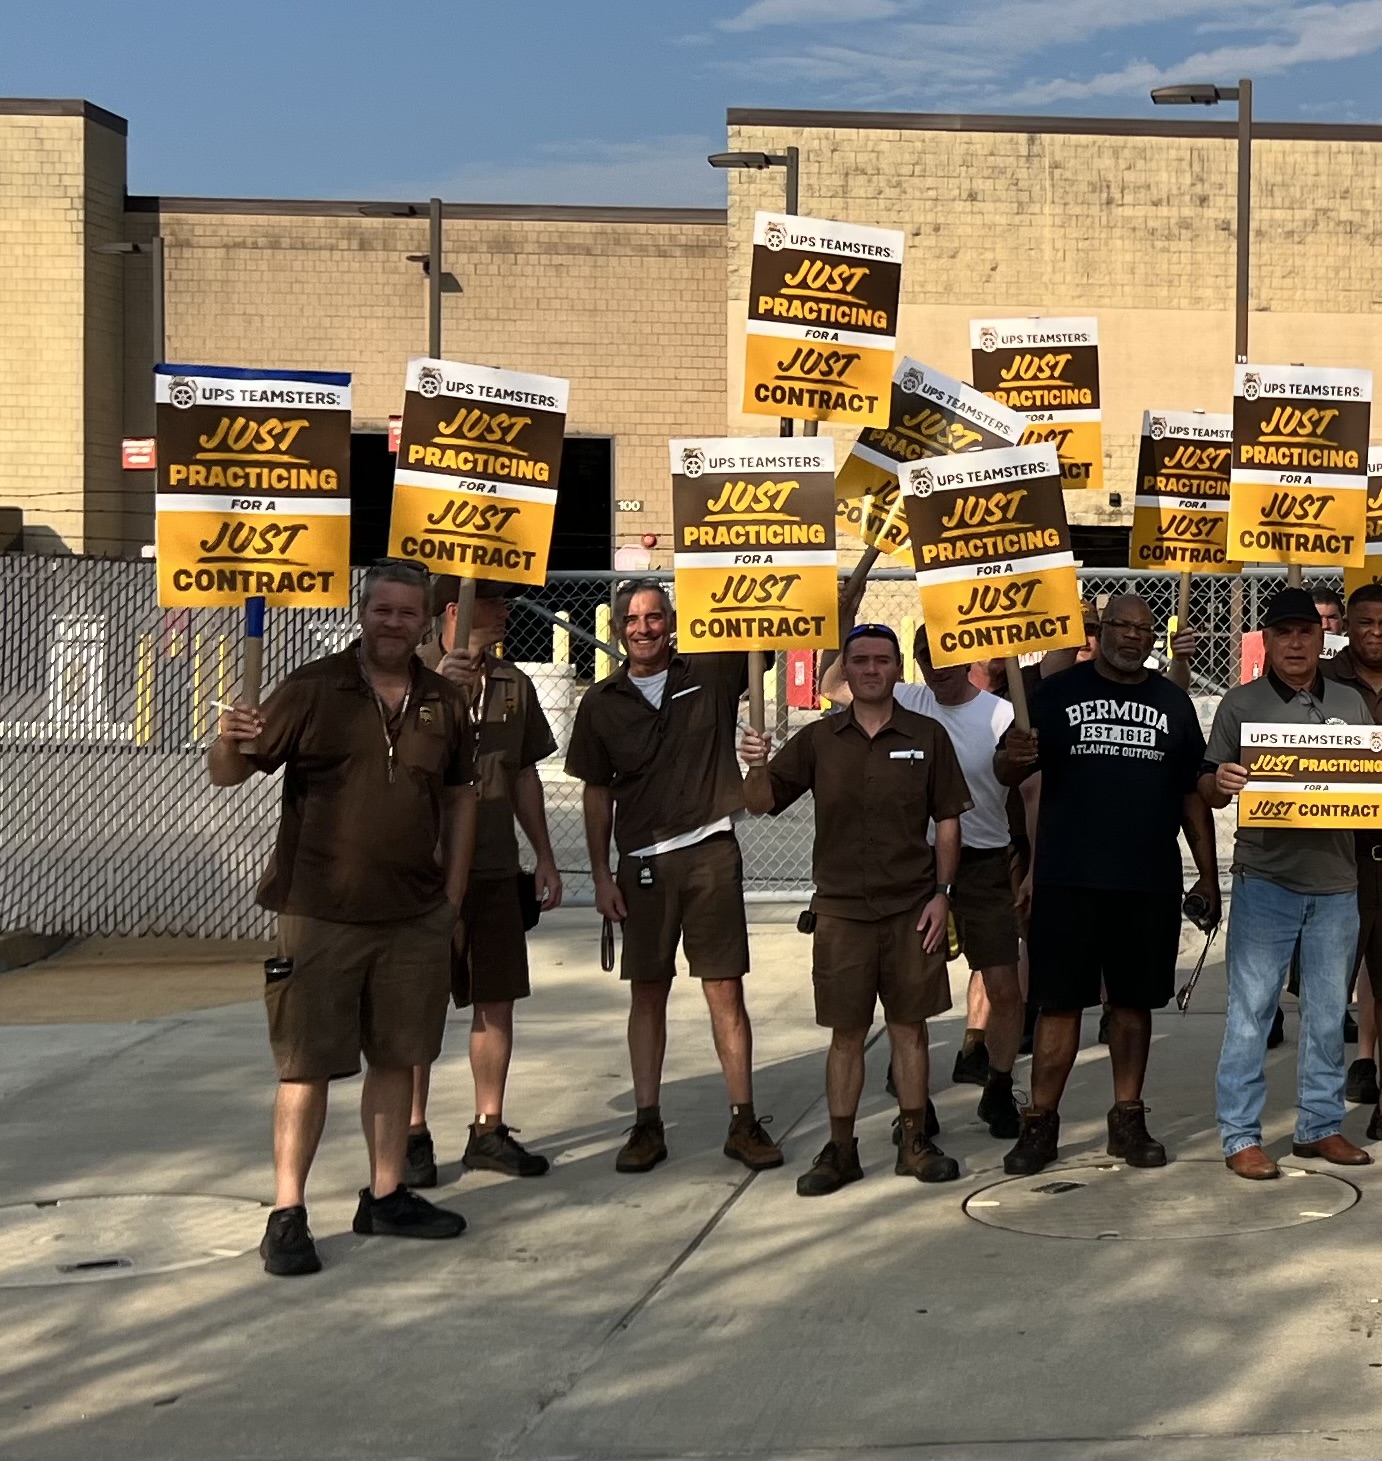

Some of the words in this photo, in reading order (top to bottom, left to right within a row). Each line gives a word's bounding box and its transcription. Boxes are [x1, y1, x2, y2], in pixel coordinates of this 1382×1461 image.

[790, 234, 816, 247] UPS
[785, 259, 870, 292] JUST
[758, 296, 888, 329] PRACTICING
[805, 329, 828, 340] FOR
[829, 331, 839, 342] A
[1001, 335, 1024, 345] UPS
[778, 347, 861, 378] JUST
[1000, 353, 1072, 380] JUST
[202, 388, 236, 401] UPS
[240, 389, 341, 405] TEAMSTERS:
[446, 381, 474, 395] UPS
[754, 383, 878, 414] CONTRACT
[922, 384, 945, 400] UPS
[1264, 383, 1285, 394] UPS
[437, 408, 531, 443] JUST
[903, 408, 983, 450] JUST
[1169, 426, 1189, 436] UPS
[1260, 407, 1338, 435] JUST
[200, 417, 309, 452] JUST
[408, 445, 549, 482] PRACTICING
[709, 456, 736, 469] UPS
[1163, 446, 1230, 470] JUST
[1241, 446, 1359, 469] PRACTICING
[169, 464, 338, 490] PRACTICING
[459, 480, 483, 492] FOR
[485, 483, 498, 493] A
[937, 473, 964, 486] UPS
[1143, 476, 1229, 495] PRACTICIN
[1280, 475, 1301, 483] FOR
[1303, 476, 1312, 484] A
[231, 499, 260, 511] FOR
[264, 500, 276, 511] A
[618, 501, 640, 511] 100
[707, 481, 799, 511] JUST
[1179, 500, 1198, 508] FOR
[1199, 501, 1207, 509] A
[1261, 492, 1334, 520] JUST
[427, 500, 520, 532] JUST
[942, 489, 1028, 528] JUST
[200, 521, 307, 555] JUST
[684, 523, 825, 546] PRACTICING
[1158, 515, 1224, 538] JUST
[401, 537, 536, 571] CONTRACT
[922, 528, 1060, 563] PRACTICING
[1139, 545, 1232, 563] CONTRAC
[1239, 531, 1354, 555] CONTRACT
[735, 554, 760, 564] FOR
[763, 554, 773, 564] A
[976, 565, 1002, 576] FOR
[1003, 563, 1013, 573] A
[174, 568, 334, 593] CONTRACT
[711, 574, 801, 603] JUST
[957, 579, 1042, 616] JUST
[690, 616, 825, 638] CONTRACT
[940, 616, 1070, 651] CONTRACT
[1066, 700, 1169, 734] BERMUDA
[1250, 734, 1277, 743] UPS
[1070, 744, 1119, 755] ATLANTIC
[1122, 747, 1165, 761] OUTPOST
[1250, 755, 1298, 771] JUST
[1250, 800, 1296, 816] JUST
[1298, 804, 1379, 817] CONTRACT
